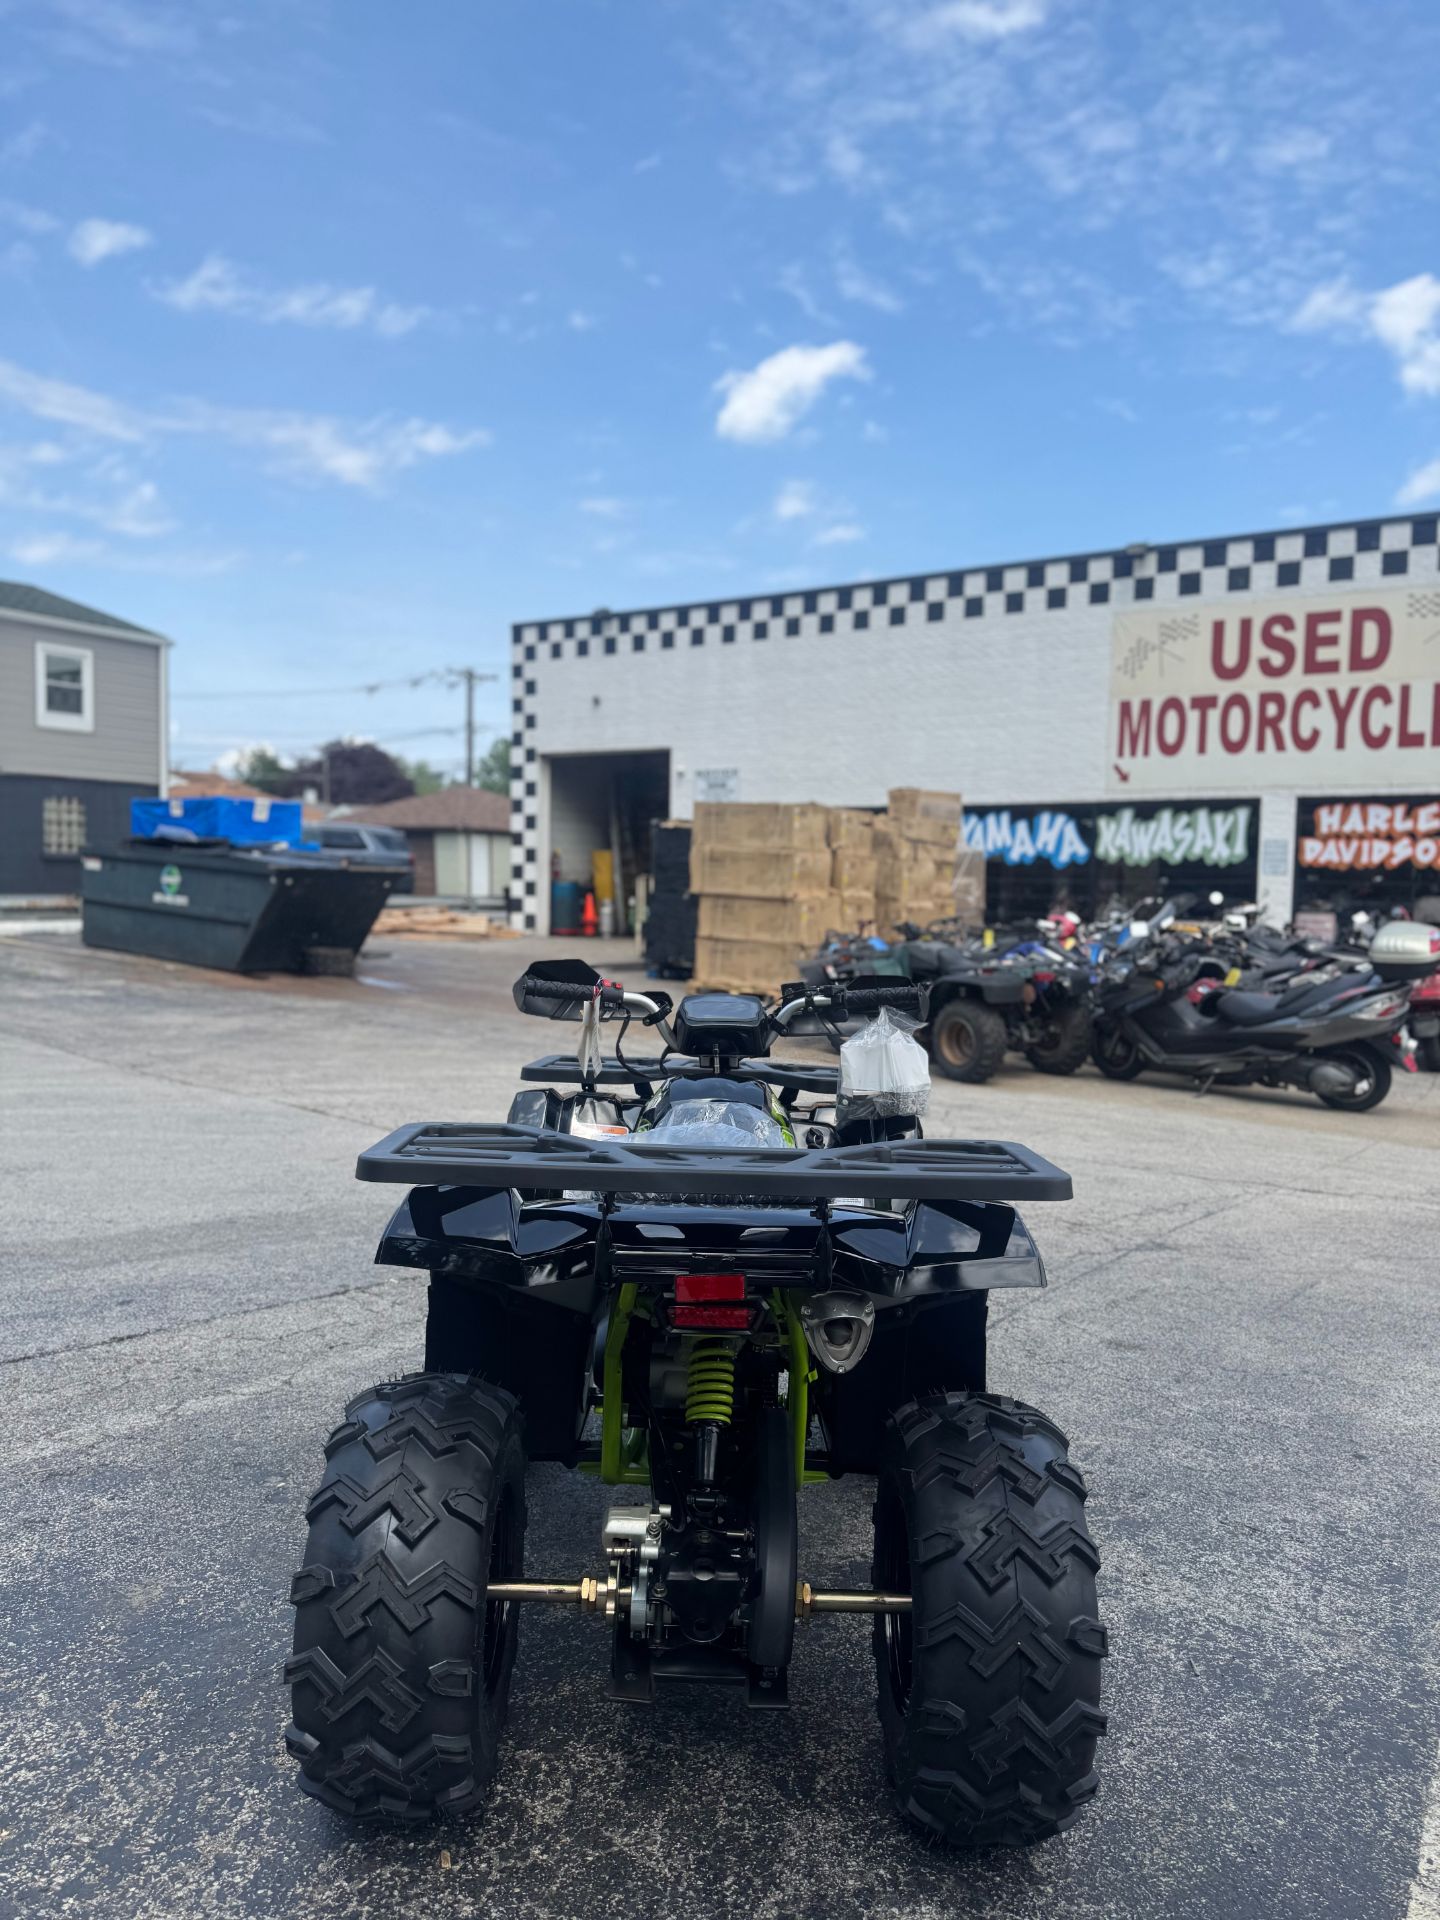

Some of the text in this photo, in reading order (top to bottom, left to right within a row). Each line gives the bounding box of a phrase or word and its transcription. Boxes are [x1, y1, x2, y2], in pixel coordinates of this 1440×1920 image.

[1210, 606, 1393, 681] USED
[962, 810, 1091, 869] YAMAHA
[1095, 807, 1251, 867] KAWASAKI
[1314, 801, 1440, 839] HARLE
[1299, 836, 1440, 871] DAVIDSO
